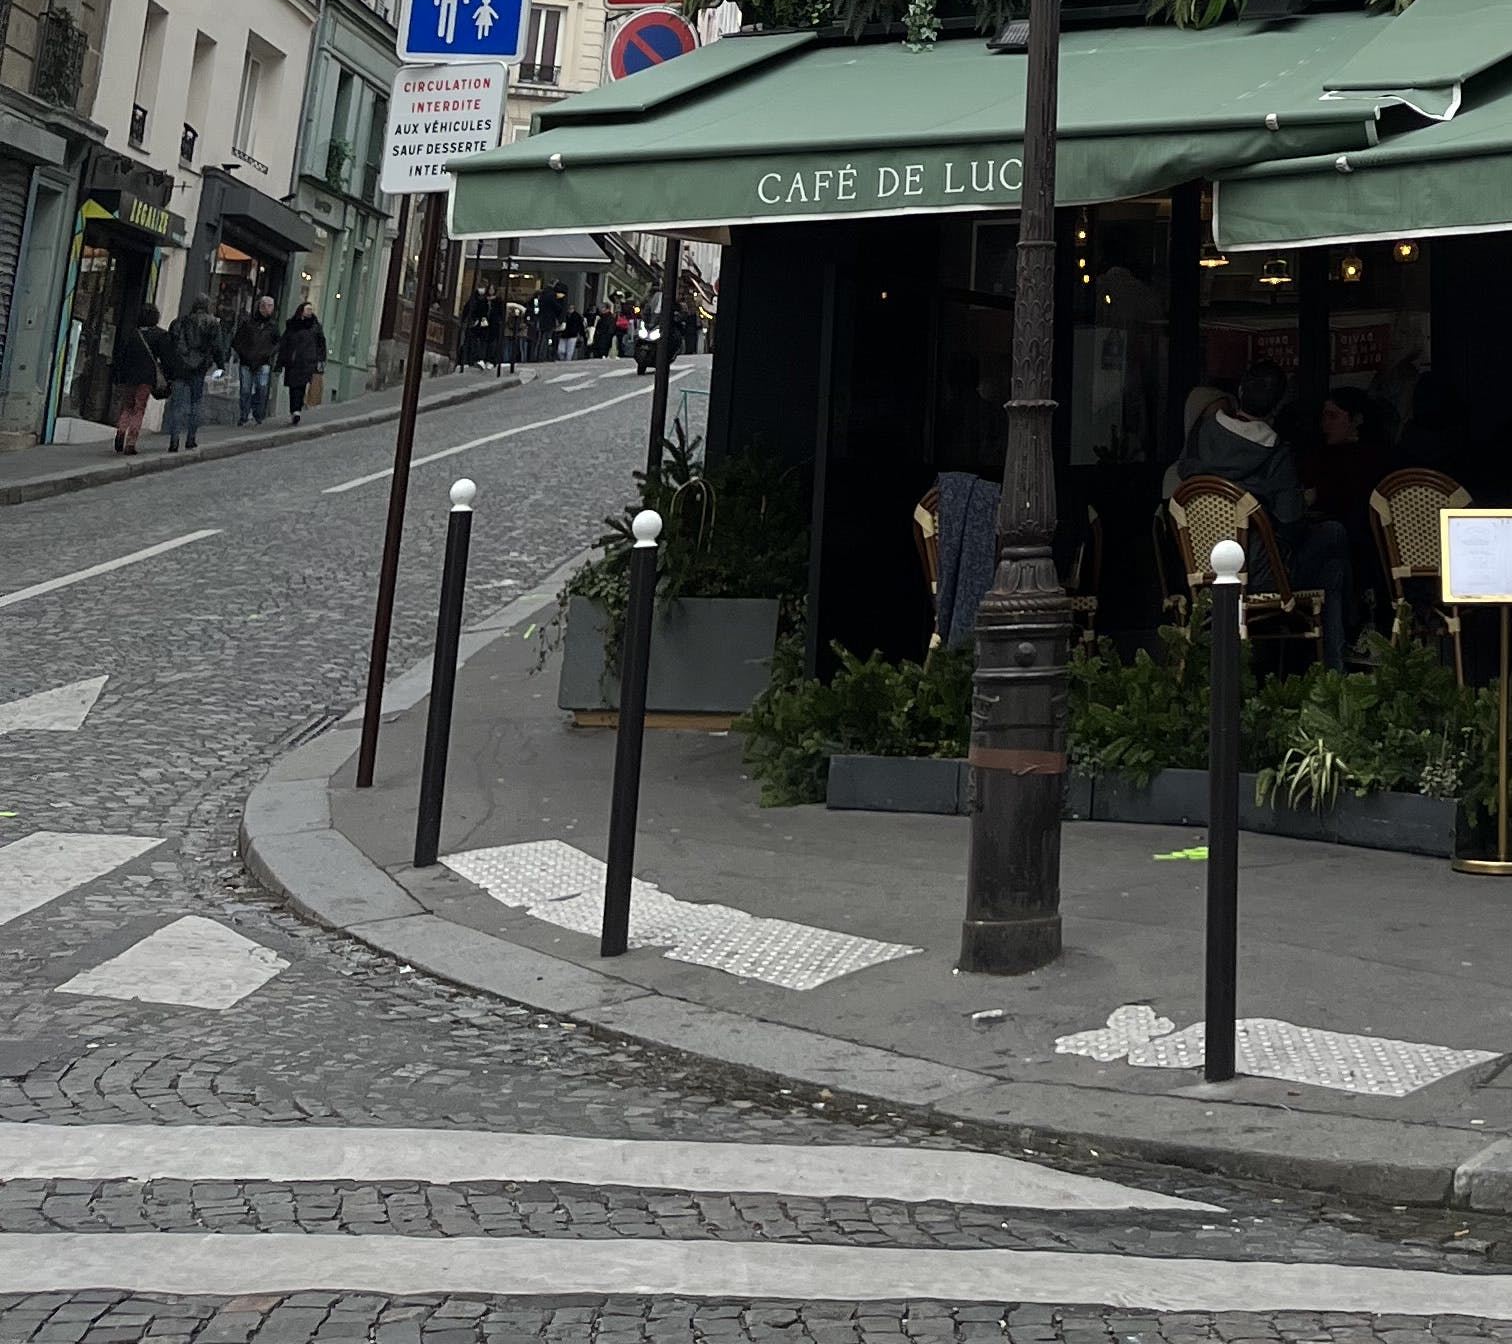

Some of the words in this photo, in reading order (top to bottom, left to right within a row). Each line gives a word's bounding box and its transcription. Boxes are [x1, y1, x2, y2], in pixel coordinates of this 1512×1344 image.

[403, 77, 491, 93] CIRCULATION
[411, 98, 481, 113] INTERDITE
[394, 123, 419, 136] AUX
[424, 119, 492, 134] VÉHICULES
[392, 144, 424, 157] SAUF
[426, 140, 487, 155] DESSERTE
[409, 164, 447, 177] INTER
[757, 163, 858, 205] CAFÉ
[877, 164, 925, 198] DE
[944, 158, 1023, 194] LUC
